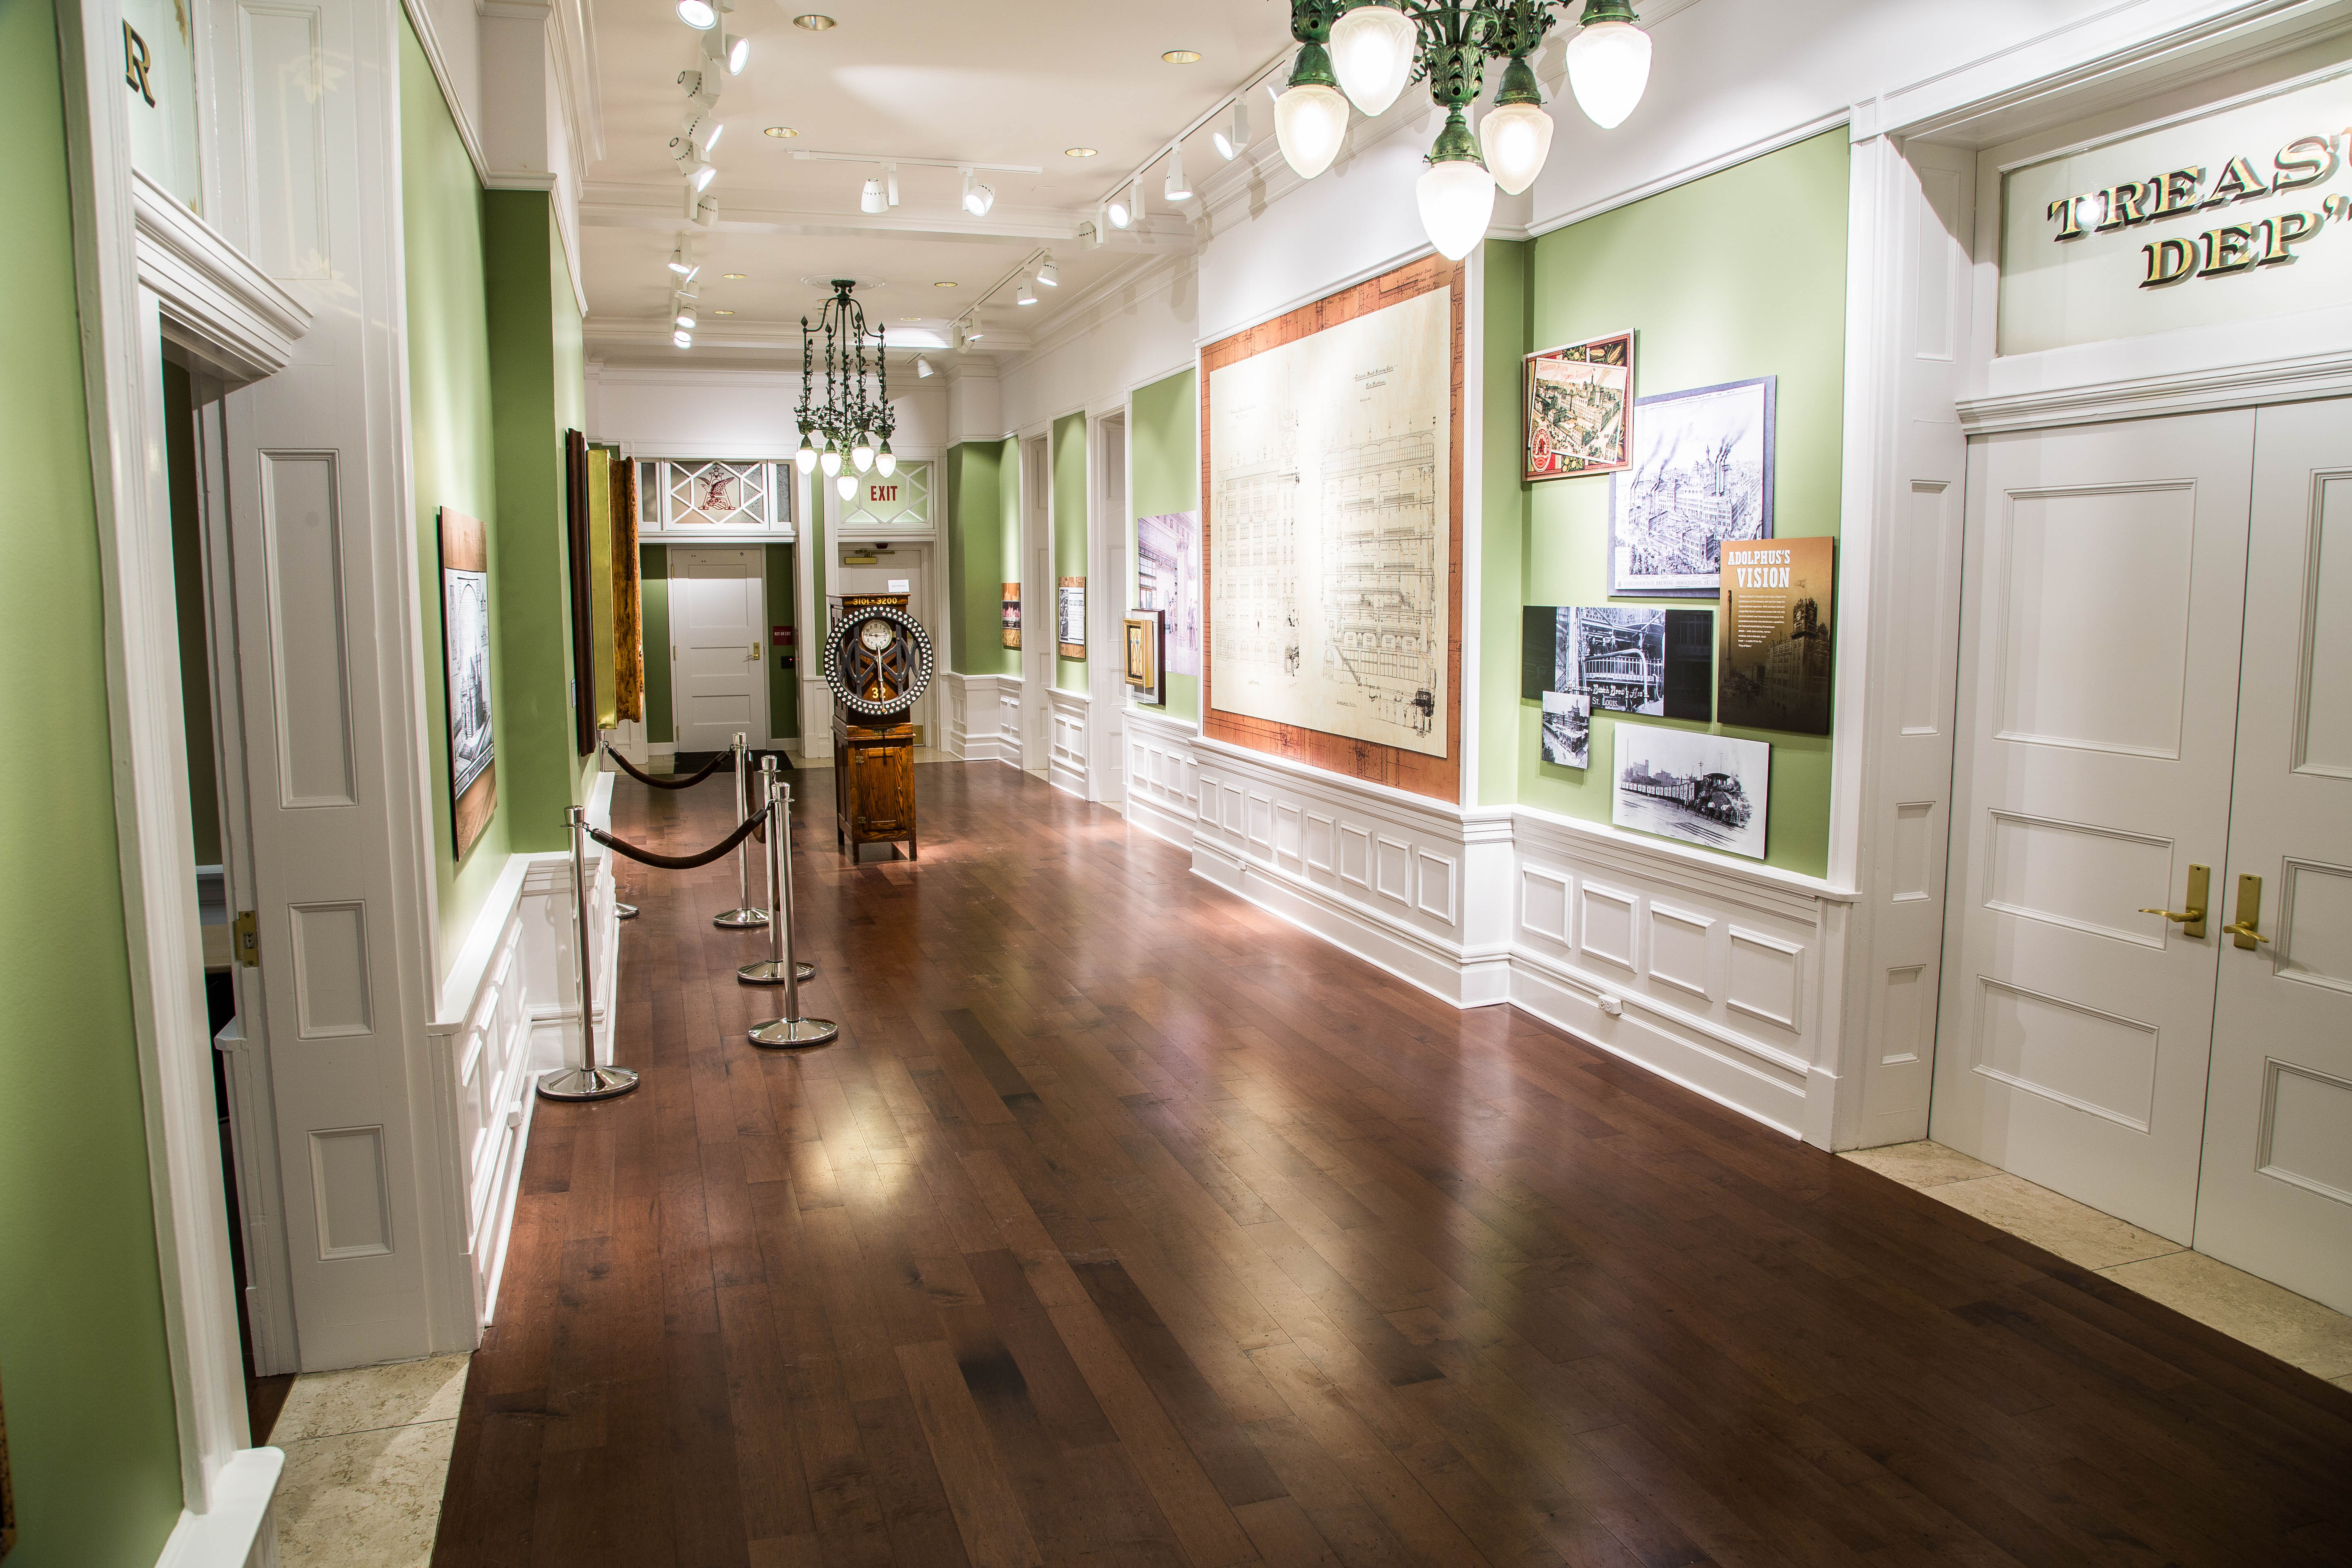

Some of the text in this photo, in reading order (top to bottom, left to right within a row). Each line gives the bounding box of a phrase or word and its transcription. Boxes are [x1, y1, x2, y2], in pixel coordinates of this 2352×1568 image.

[2047, 126, 2352, 242] TREAS
[871, 486, 898, 501] EXIT
[1728, 550, 1790, 566] ADOLPHUS'S
[1737, 567, 1790, 589] VISION
